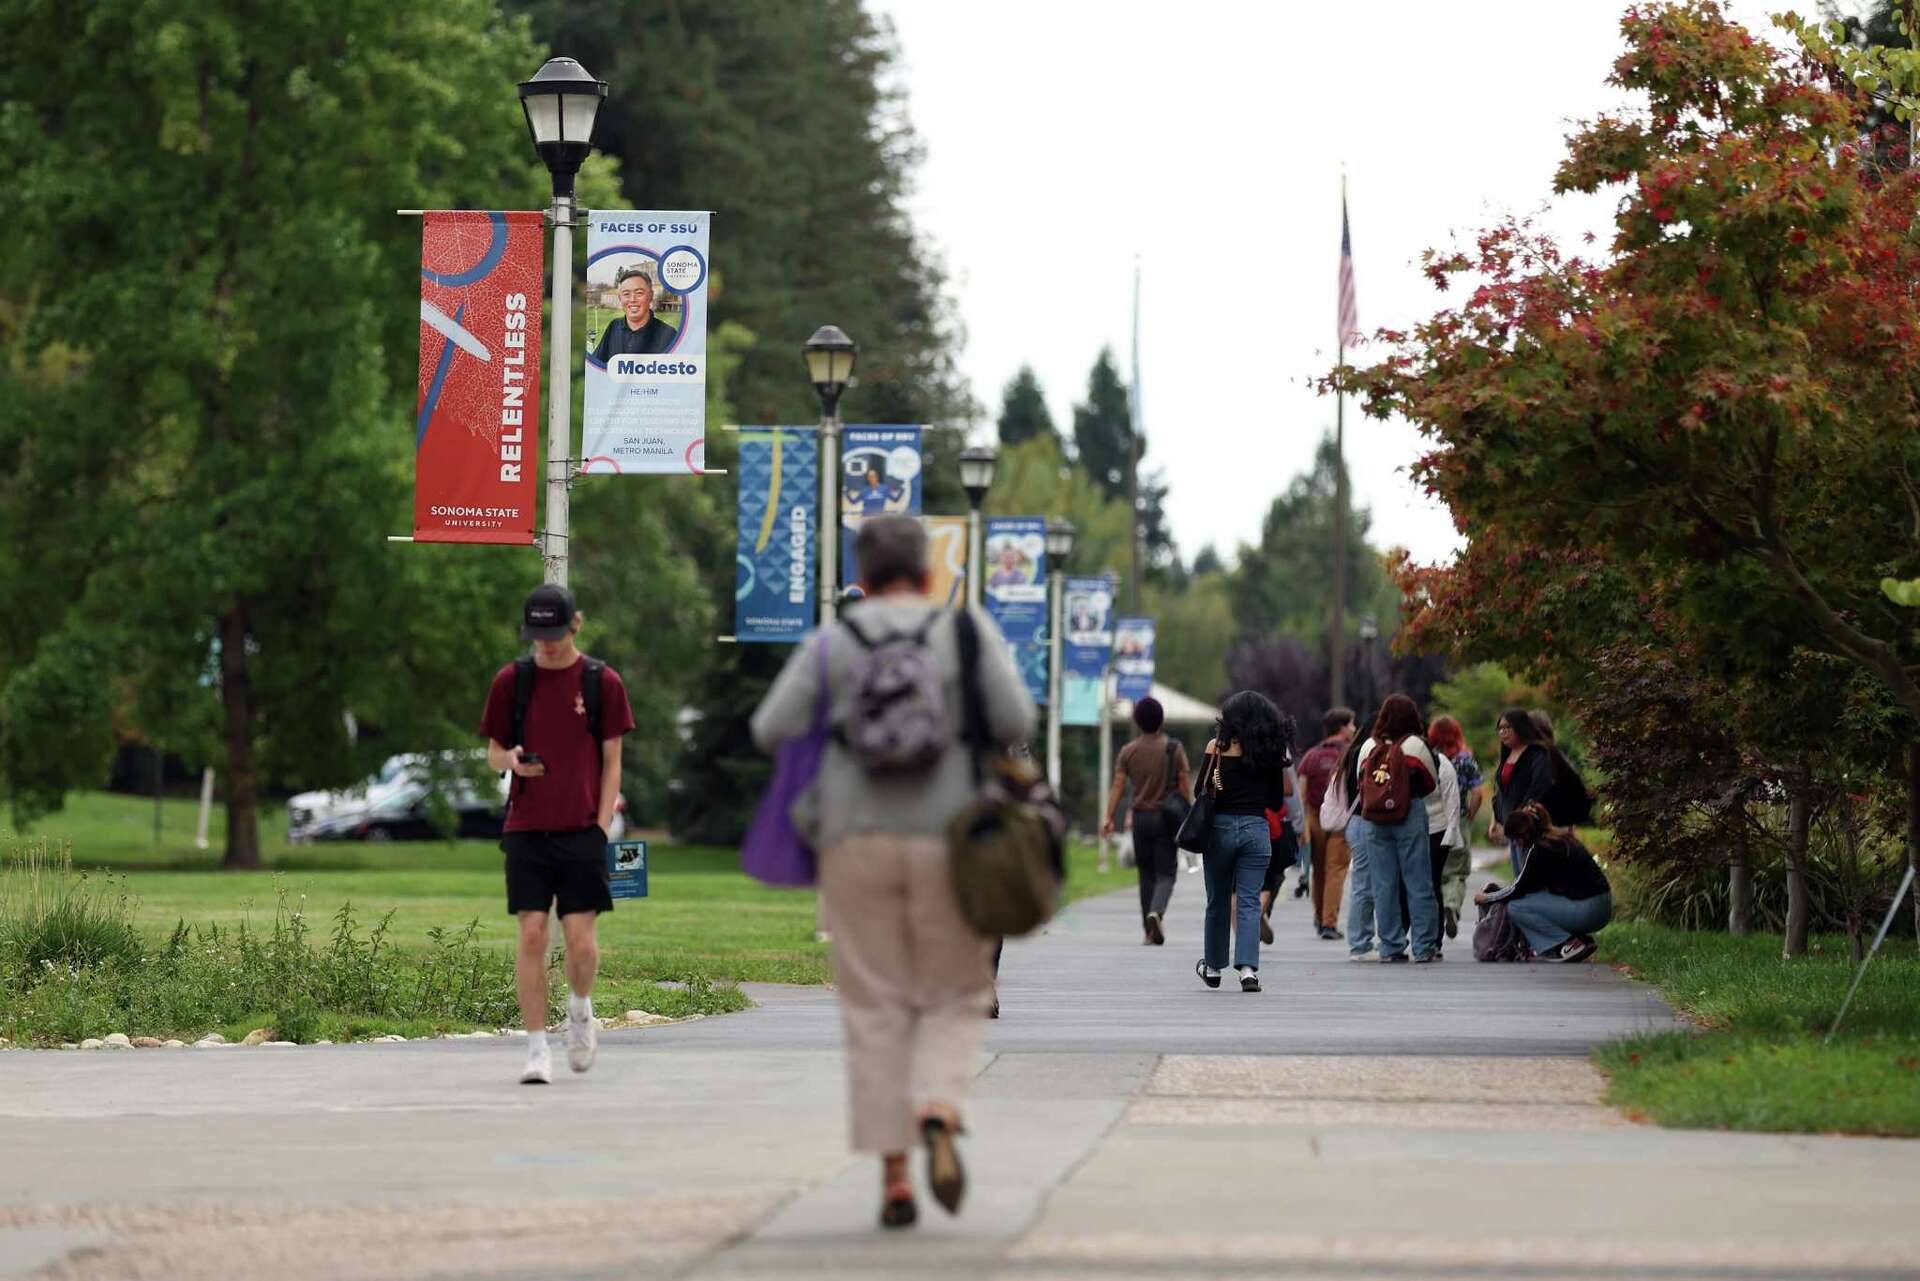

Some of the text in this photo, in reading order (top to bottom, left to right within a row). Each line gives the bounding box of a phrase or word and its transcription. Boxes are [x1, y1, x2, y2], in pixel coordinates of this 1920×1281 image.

[600, 222, 698, 234] FACES OF SSU
[617, 360, 697, 376] Modesto
[500, 292, 527, 483] RELENTLESS
[623, 437, 666, 446] SAN JUAN,
[612, 447, 674, 455] METRO MANILA
[431, 506, 519, 518] SONOMA STATE
[444, 520, 503, 528] UNIVERSITY
[789, 506, 806, 603] ENGAGED
